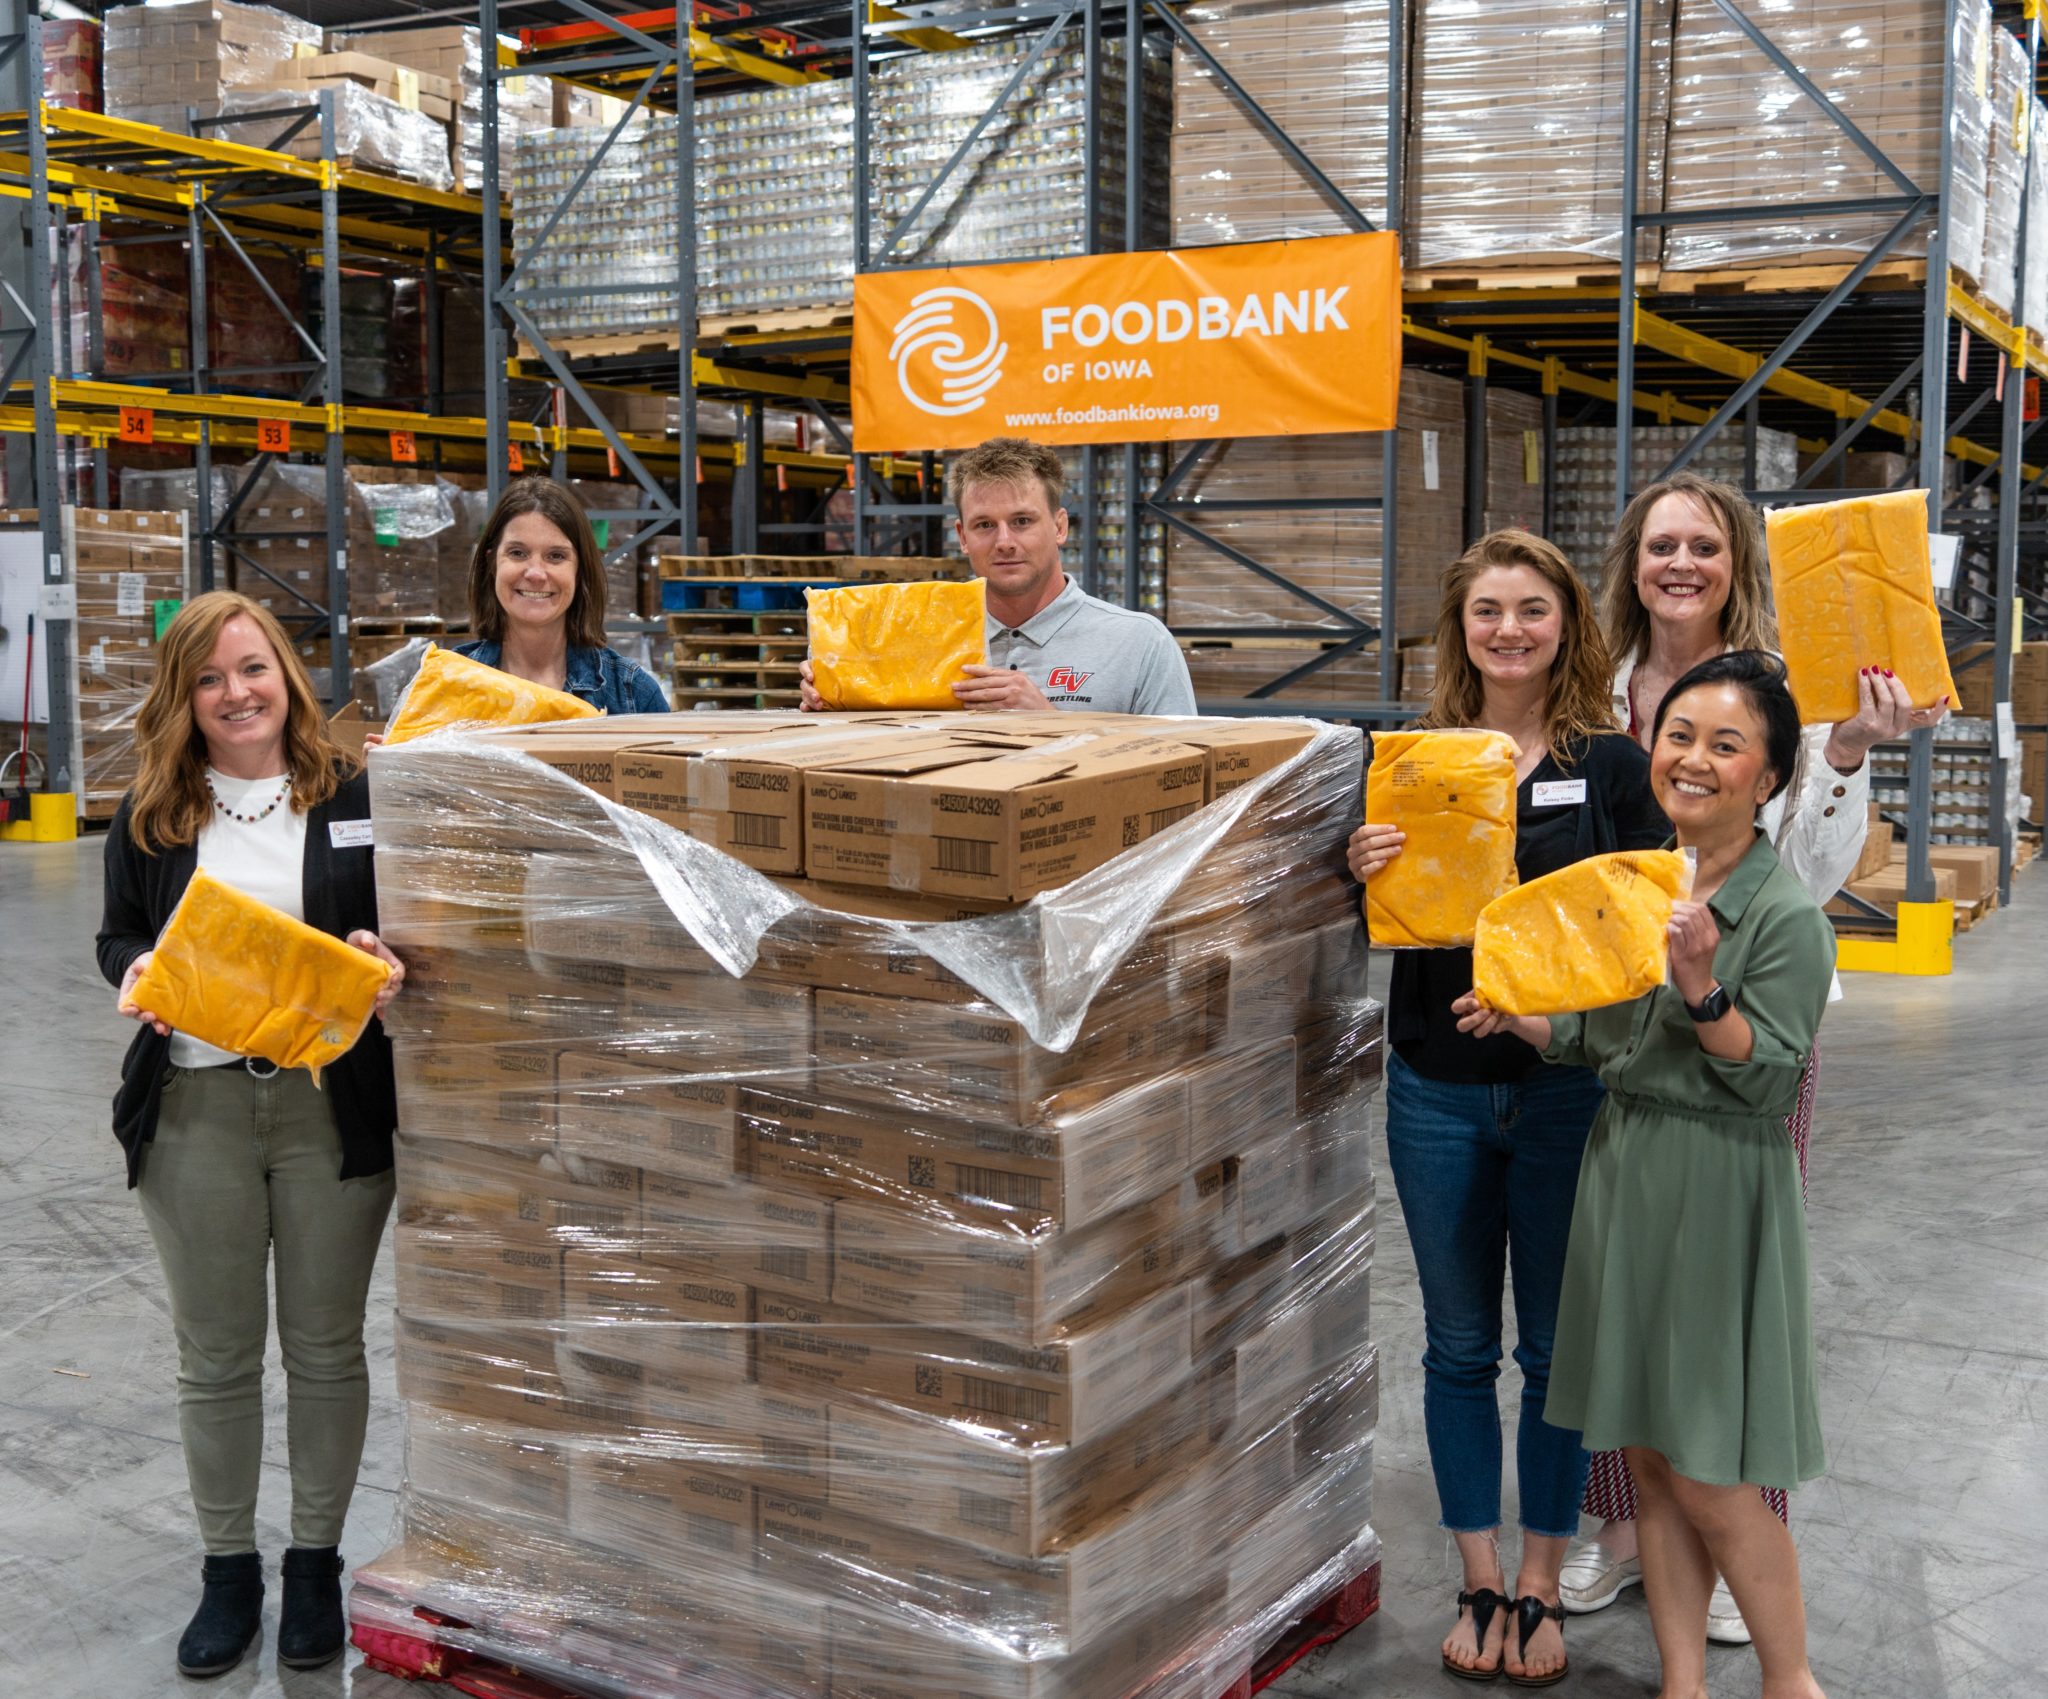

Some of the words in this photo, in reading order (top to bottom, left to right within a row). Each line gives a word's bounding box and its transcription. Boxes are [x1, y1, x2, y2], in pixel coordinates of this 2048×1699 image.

[1041, 285, 1350, 350] FOODBANK
[1043, 363, 1075, 383] OF
[1085, 359, 1153, 381] IOWA
[126, 416, 145, 435] 54
[1005, 403, 1220, 428] www.foodbankiowa.org
[264, 428, 283, 445] 53
[397, 438, 411, 454] 52
[1046, 665, 1095, 694] GV
[1046, 695, 1093, 703] RESTLING
[622, 767, 637, 777] LAND
[646, 769, 664, 780] LAKES
[811, 786, 828, 798] LAND
[838, 790, 857, 801] LAKES
[812, 811, 841, 823] MACARONI
[841, 814, 853, 824] AND
[854, 815, 875, 827] CHEESE
[1020, 806, 1037, 820] LAND
[1046, 800, 1064, 815] LAKES
[812, 821, 826, 831] WITH
[826, 822, 845, 833] WHOLE
[846, 824, 864, 834] GRAIN
[1020, 826, 1048, 841] MACARONI
[1048, 823, 1059, 836] AND
[1059, 819, 1078, 833] CHEESE
[1078, 815, 1096, 829] ENTREE
[1020, 841, 1033, 853] WITH
[1034, 836, 1052, 850] WHOLE
[1052, 833, 1068, 846] GRAIN
[757, 1101, 778, 1114] LAND
[791, 1107, 814, 1120] LAKES
[794, 1128, 807, 1139] AND
[837, 1135, 863, 1149] ENTREE
[763, 1303, 785, 1317] LAND
[798, 1310, 822, 1324] LAKES
[764, 1498, 786, 1513] LAND
[799, 1507, 823, 1521] LAKES
